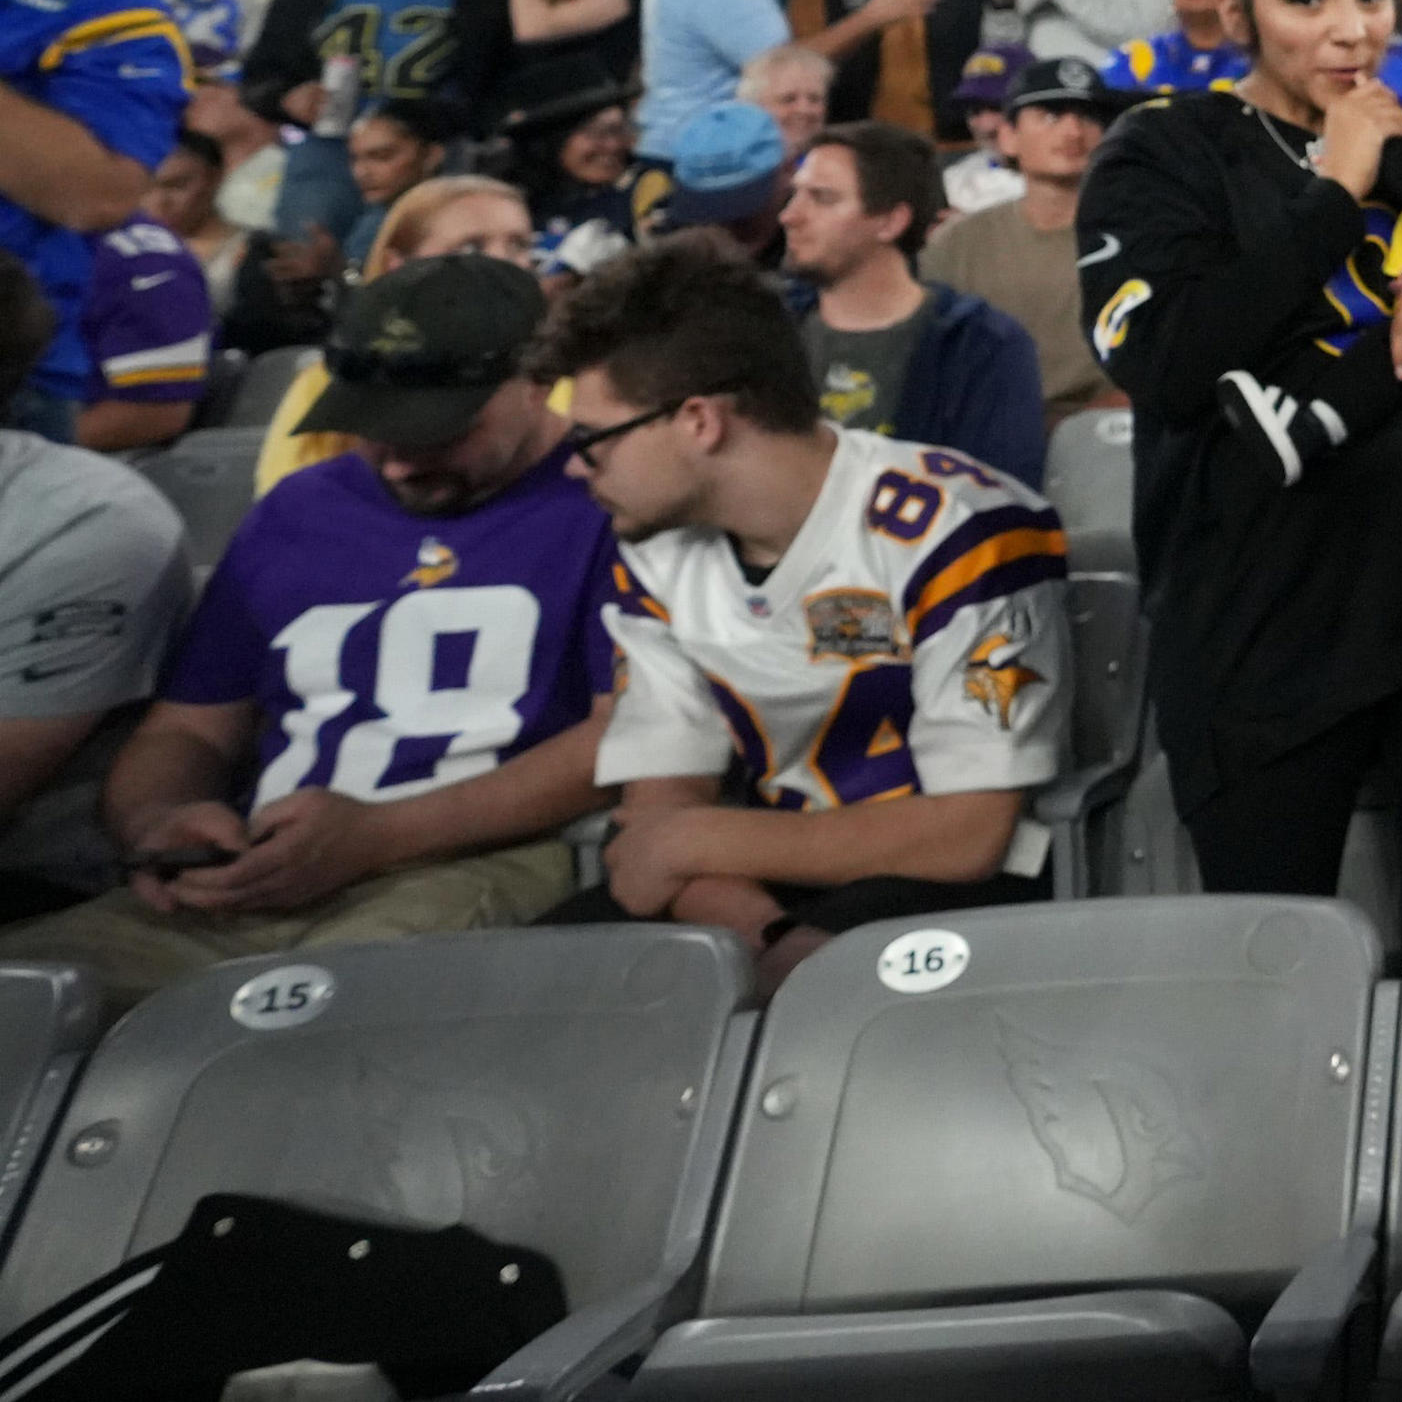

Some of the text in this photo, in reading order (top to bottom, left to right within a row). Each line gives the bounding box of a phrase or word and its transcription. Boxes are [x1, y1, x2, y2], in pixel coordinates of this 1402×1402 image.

[251, 584, 541, 815] 18
[903, 947, 944, 975] 16
[260, 982, 310, 1013] 15
